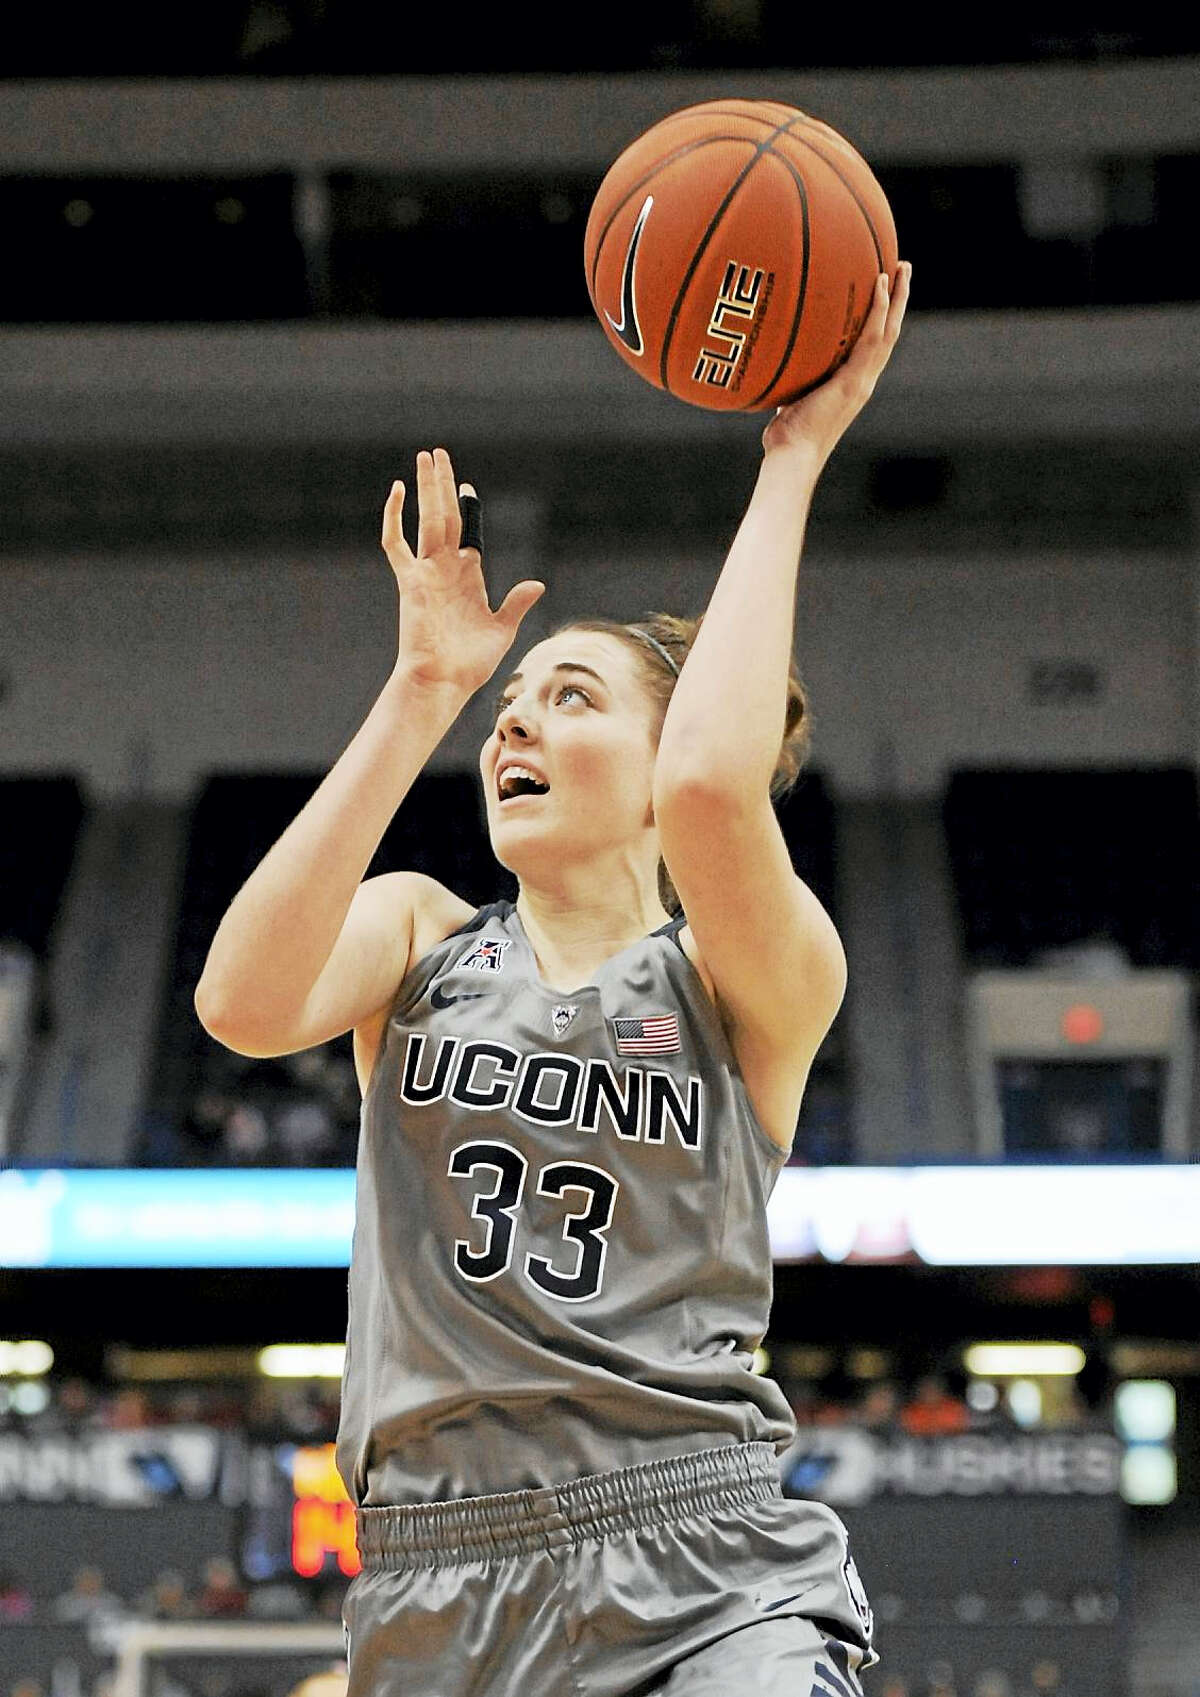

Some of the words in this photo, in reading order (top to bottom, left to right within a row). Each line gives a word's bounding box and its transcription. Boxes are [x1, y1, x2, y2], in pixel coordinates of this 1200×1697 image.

[692, 260, 763, 391] ELITE
[400, 1033, 702, 1150] UCONN
[447, 1140, 619, 1302] 33
